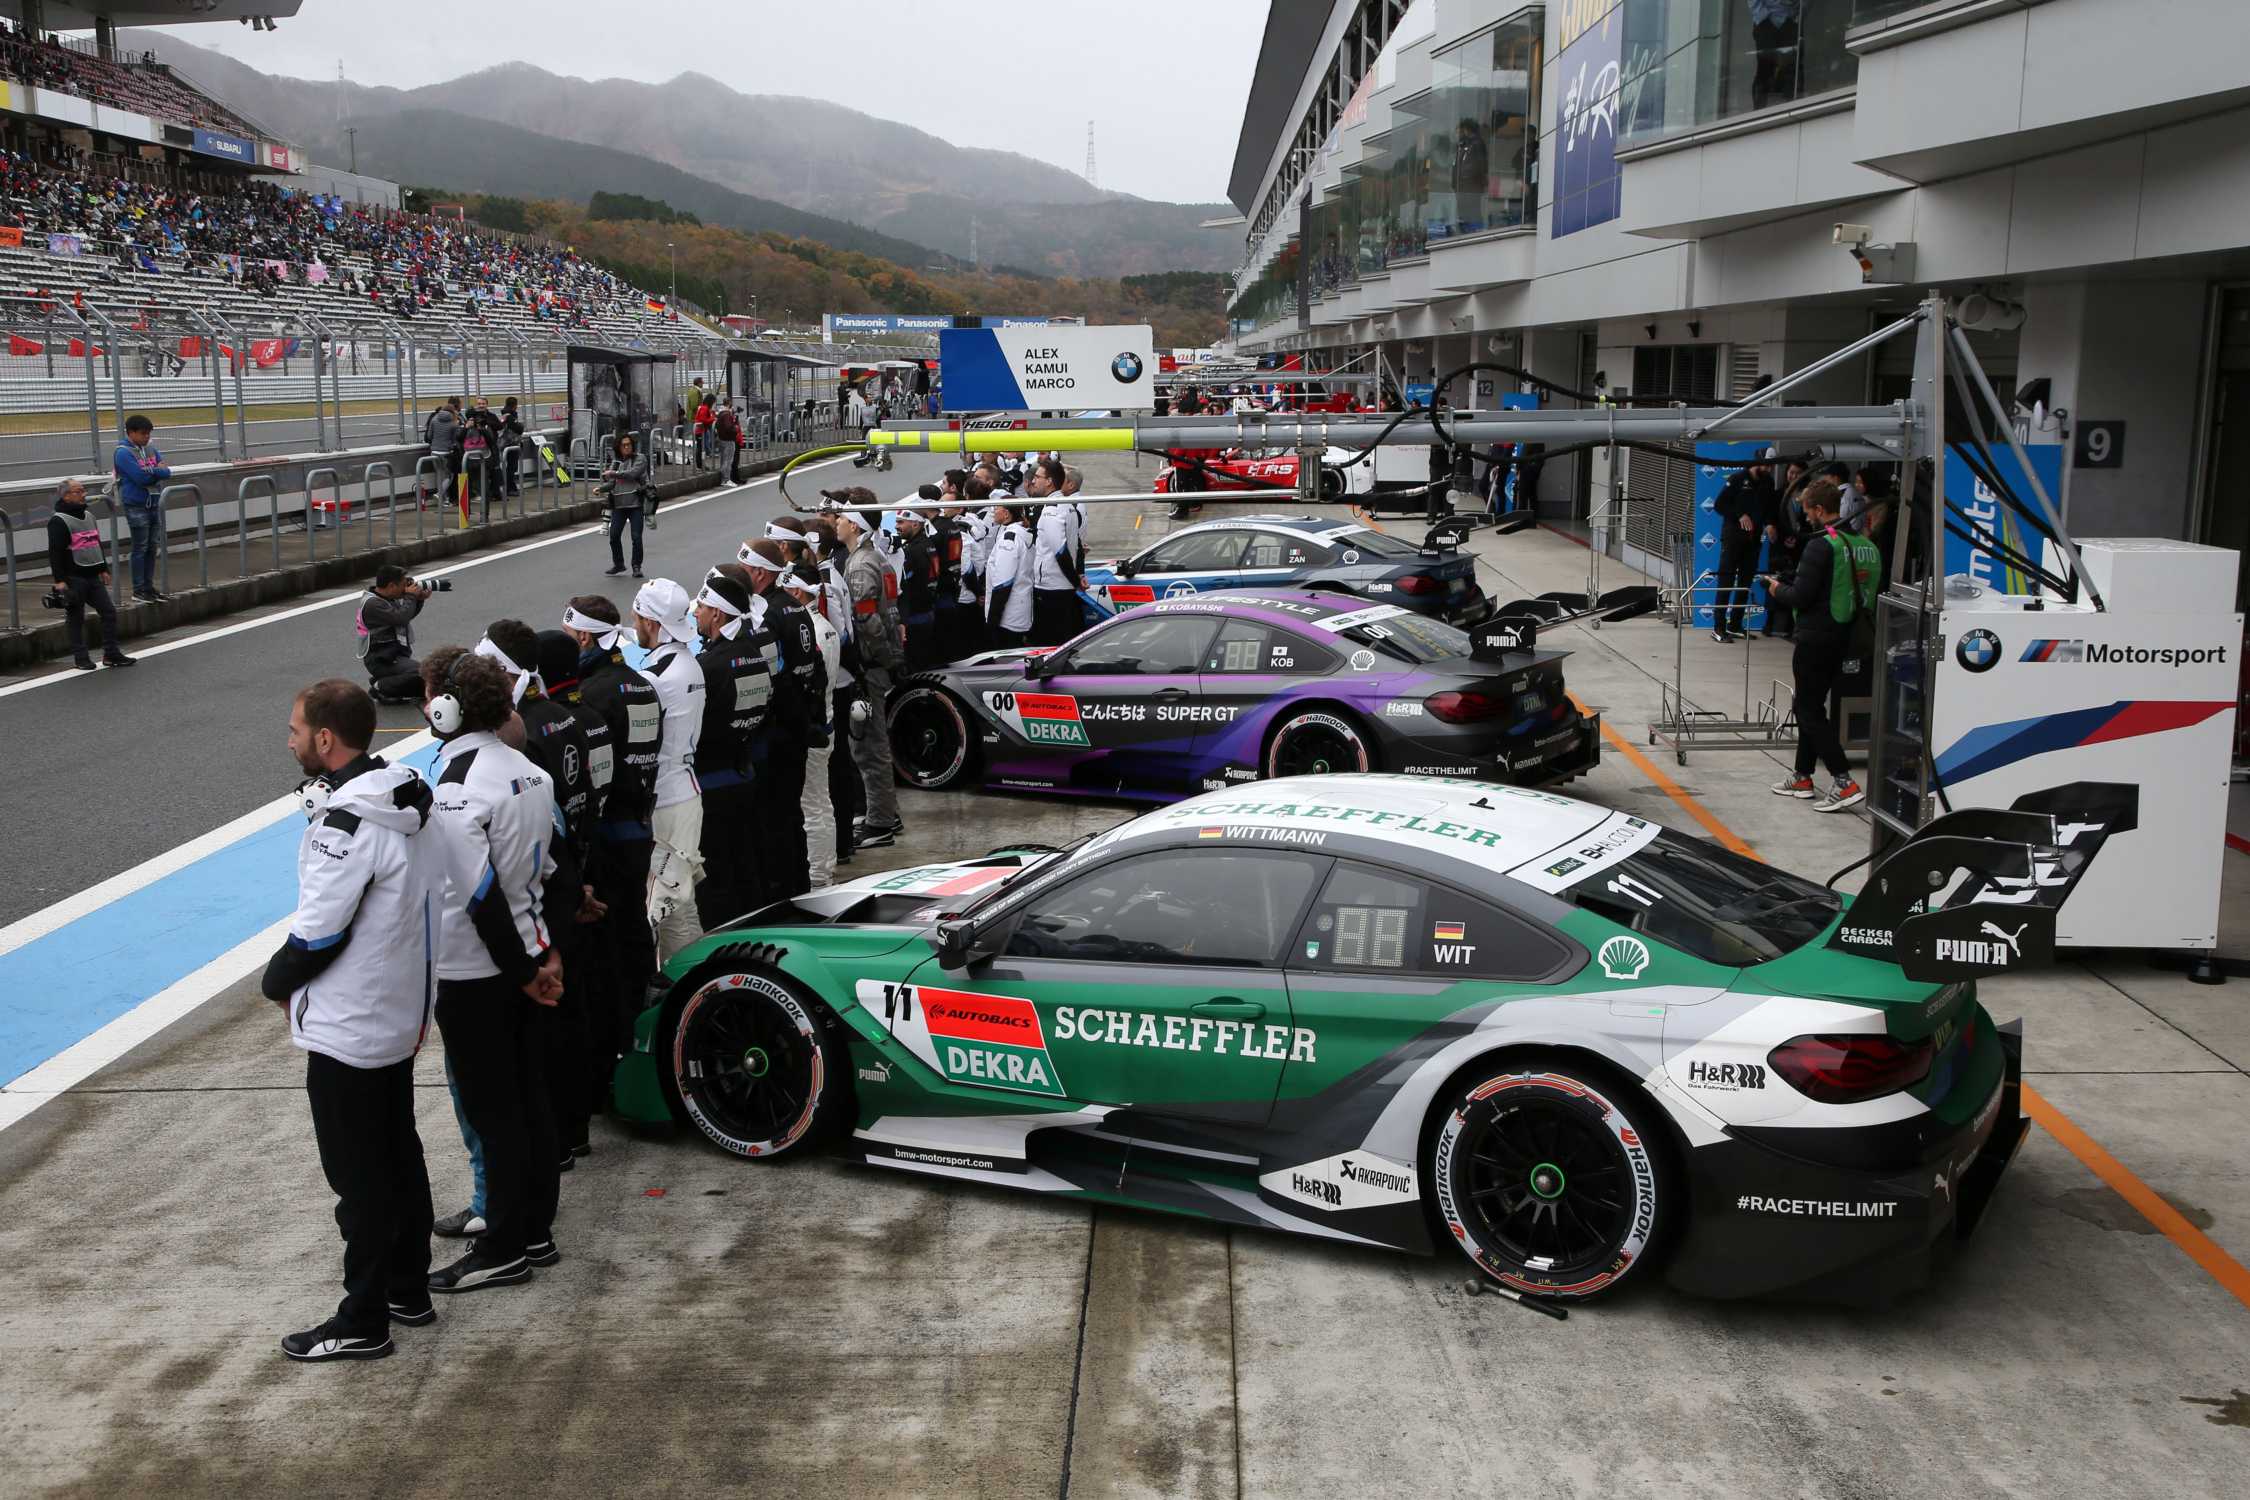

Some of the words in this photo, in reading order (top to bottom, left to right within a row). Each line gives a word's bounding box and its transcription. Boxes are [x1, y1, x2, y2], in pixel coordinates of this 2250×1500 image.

[216, 140, 242, 156] SUBARU
[835, 317, 888, 328] Panasonic
[897, 317, 949, 328] Panasonic
[1002, 319, 1050, 329] Panason
[1024, 348, 1060, 360] ALEX
[1025, 363, 1068, 375] KAMUI
[1026, 378, 1075, 389] MARCO
[1478, 382, 1493, 395] 12
[964, 420, 1012, 430] HEIGO
[2087, 427, 2112, 462] 9
[1436, 535, 1457, 545] PUMA
[1288, 556, 1306, 564] ZAN
[1098, 586, 1108, 597] 4
[1168, 604, 1225, 613] KOBAYASHI
[1362, 624, 1394, 639] 00
[1486, 635, 1517, 647] PUMA
[1270, 657, 1295, 667] KOB
[2086, 643, 2228, 668] Motorsport
[992, 692, 1015, 712] 00
[1081, 704, 1147, 721] こんにちは
[1156, 705, 1212, 721] SUPER
[1214, 706, 1239, 721] GT
[1029, 722, 1083, 741] DEKRA
[1403, 765, 1479, 775] #RACETHELIMIT
[1166, 799, 1503, 850] SCHAEFFLER
[1224, 824, 1327, 847] WITTMANN
[1606, 873, 1664, 907] 11
[1840, 927, 1894, 938] BECKER
[1840, 934, 1894, 946] CARBON
[1433, 943, 1477, 965] WIT
[1936, 938, 2008, 966] PUMA
[881, 983, 914, 1022] 11
[944, 1006, 1033, 1029] AUTOBACS
[1053, 1004, 1319, 1064] SCHAEFFLER
[858, 1066, 887, 1083] PUMA
[946, 1045, 1051, 1088] DEKRA
[1689, 1061, 1736, 1084] H&R
[895, 1147, 994, 1169] bmw-motorsport.com
[1292, 1172, 1322, 1198] H&R
[1736, 1194, 1898, 1219] #RACETHELIMIT
